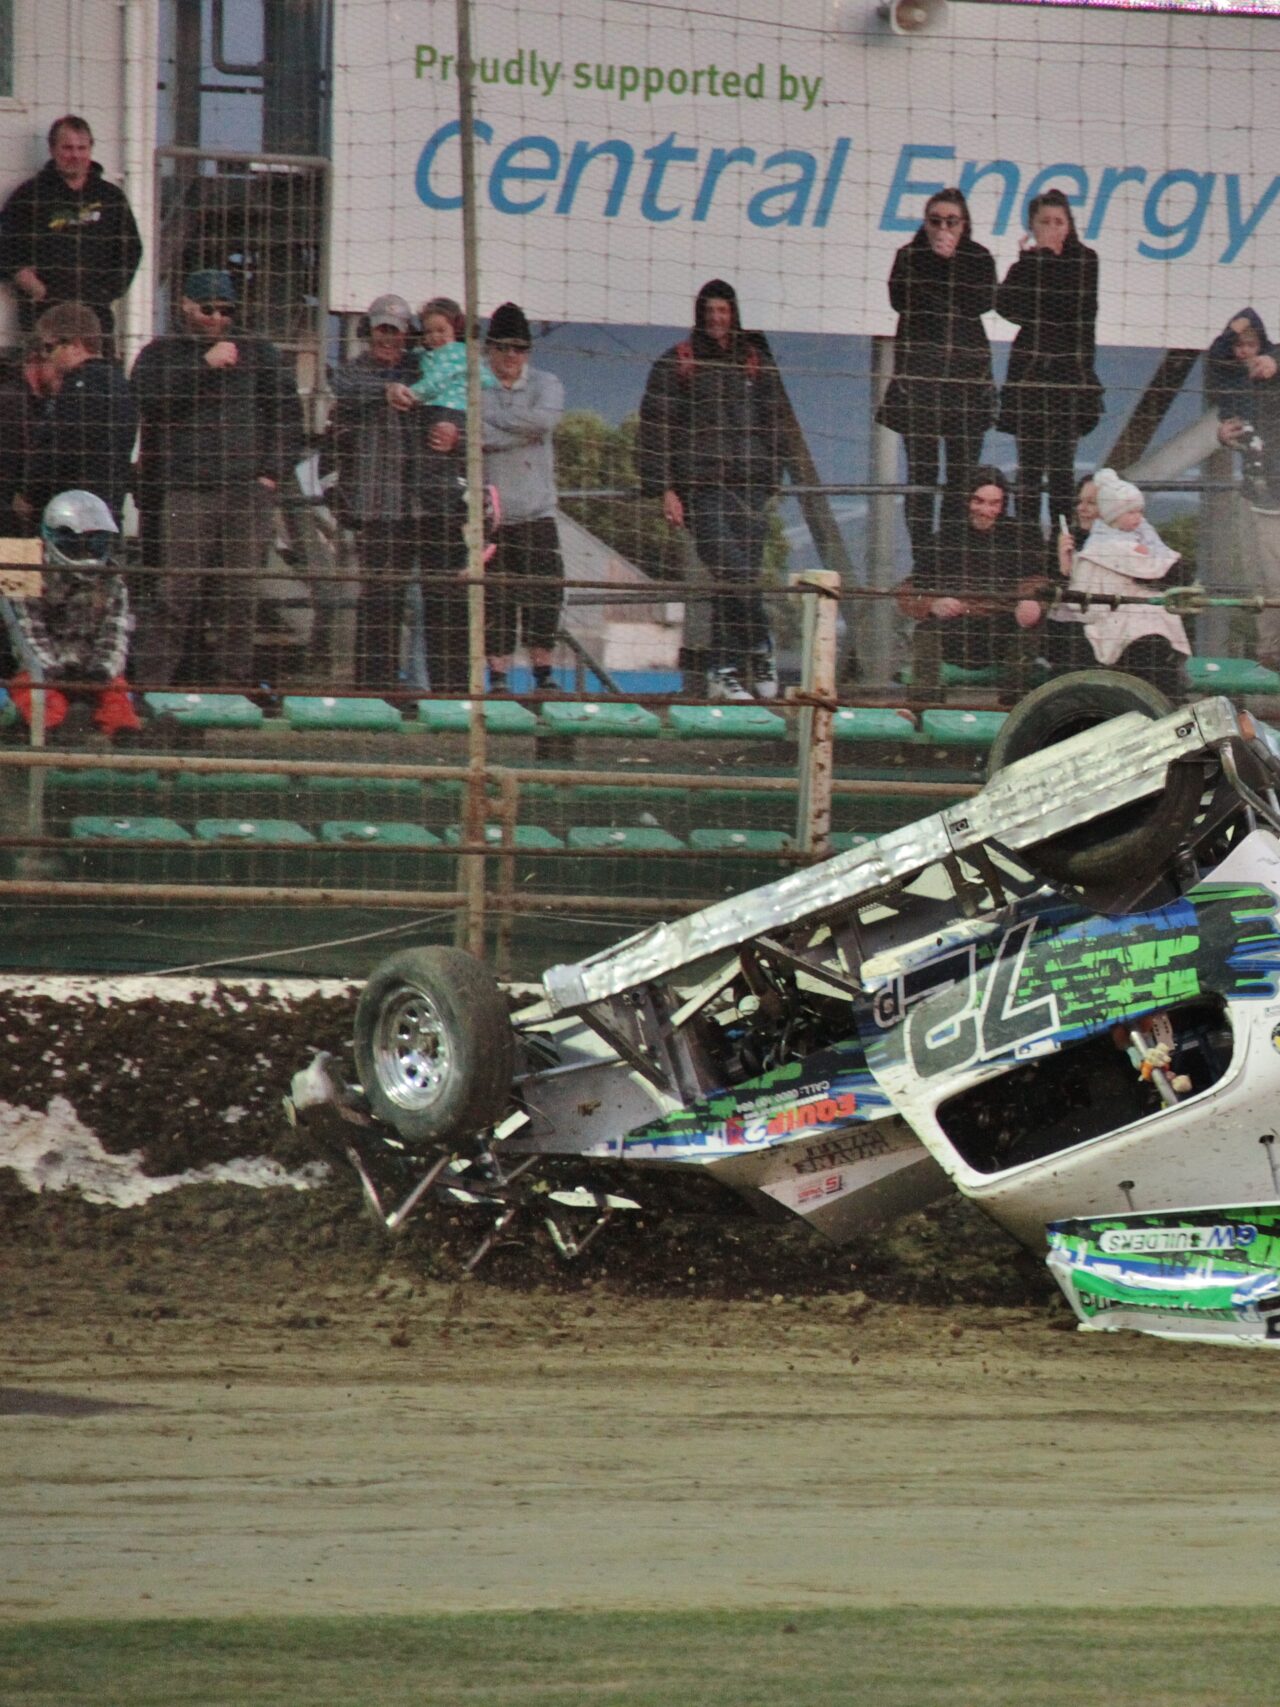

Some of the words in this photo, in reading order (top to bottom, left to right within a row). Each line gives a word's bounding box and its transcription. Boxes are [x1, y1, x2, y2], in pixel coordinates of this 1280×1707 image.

[573, 61, 765, 101] supported
[780, 64, 823, 111] by
[414, 119, 852, 228] Central
[1206, 1225, 1258, 1249] GW
